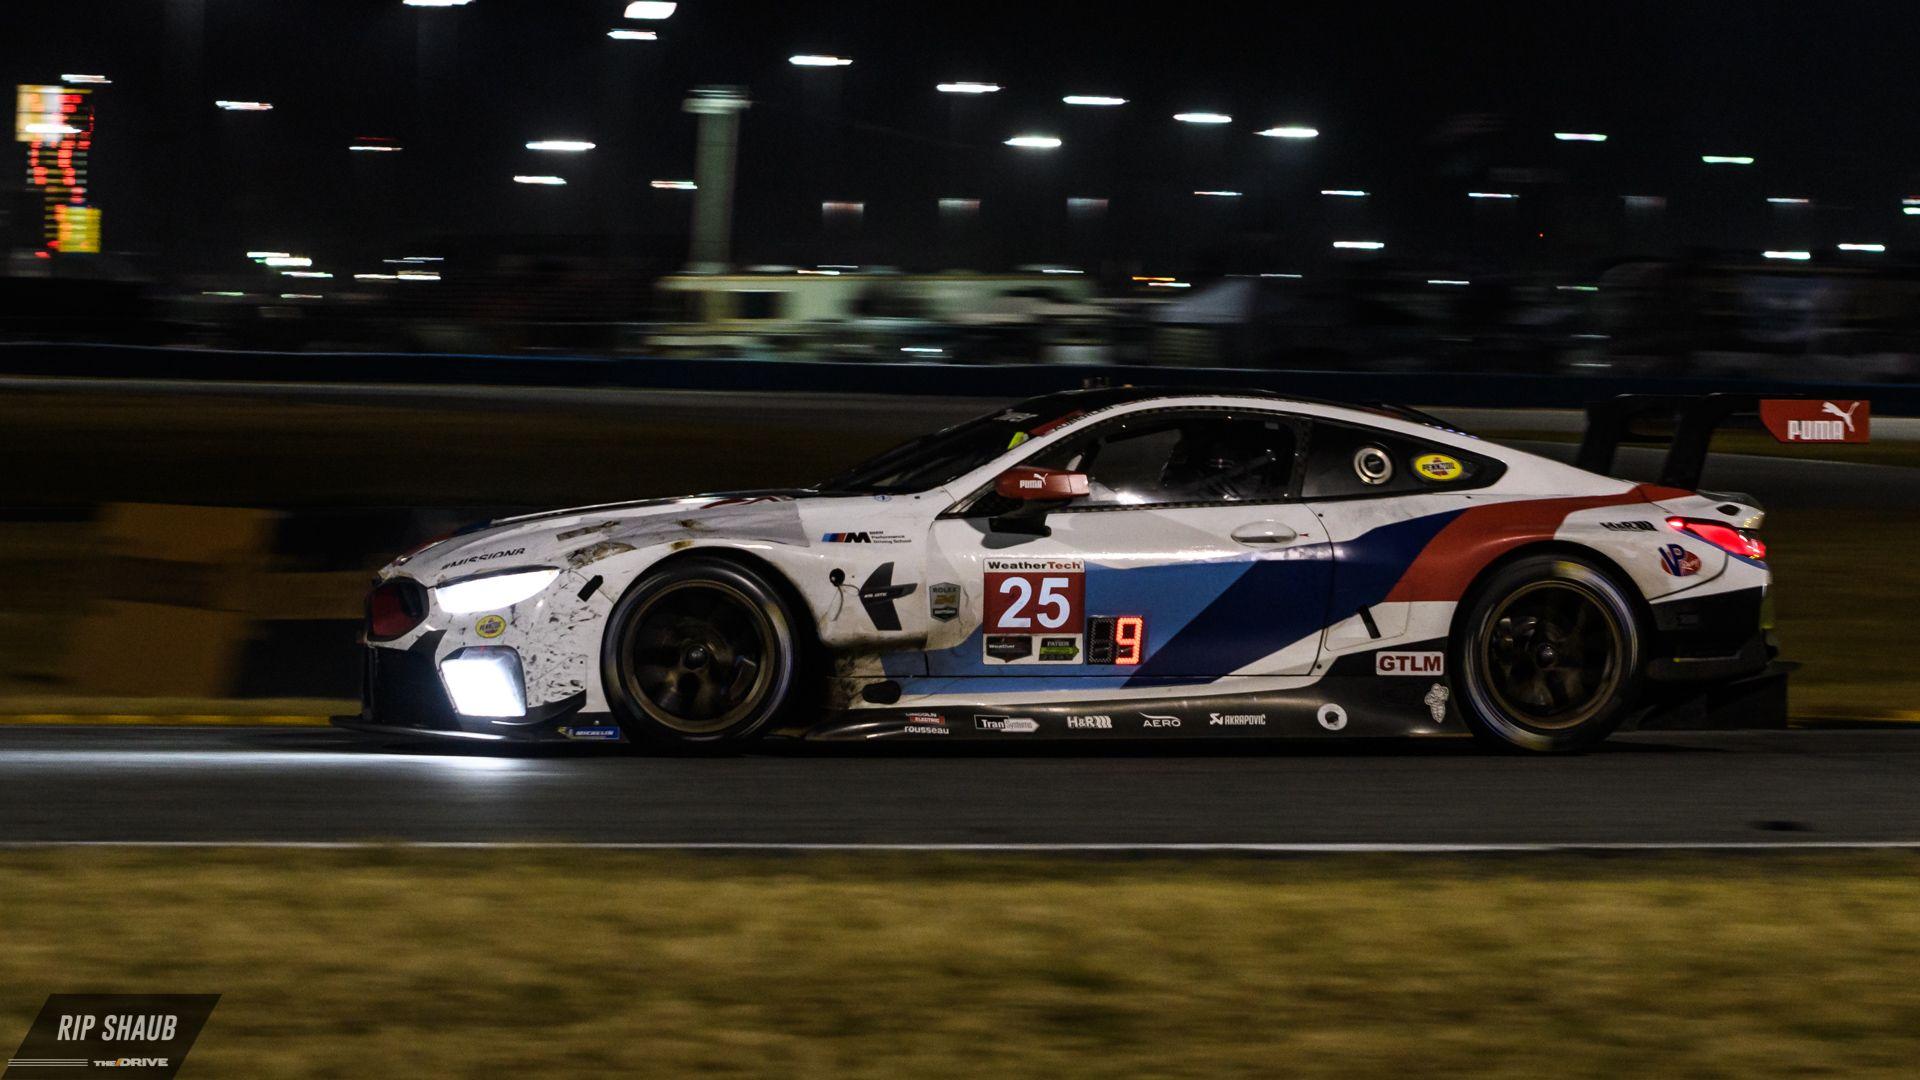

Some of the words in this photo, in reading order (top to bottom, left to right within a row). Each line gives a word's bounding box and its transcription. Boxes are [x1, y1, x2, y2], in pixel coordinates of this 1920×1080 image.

[1787, 420, 1844, 440] PUMA
[1019, 479, 1042, 489] PUMA
[988, 561, 1081, 570] WeatherTech
[997, 576, 1071, 628] 25
[1115, 617, 1143, 665] 9
[1379, 655, 1441, 672] GTLM
[904, 725, 949, 735] rousseau
[1143, 719, 1181, 728] AERO
